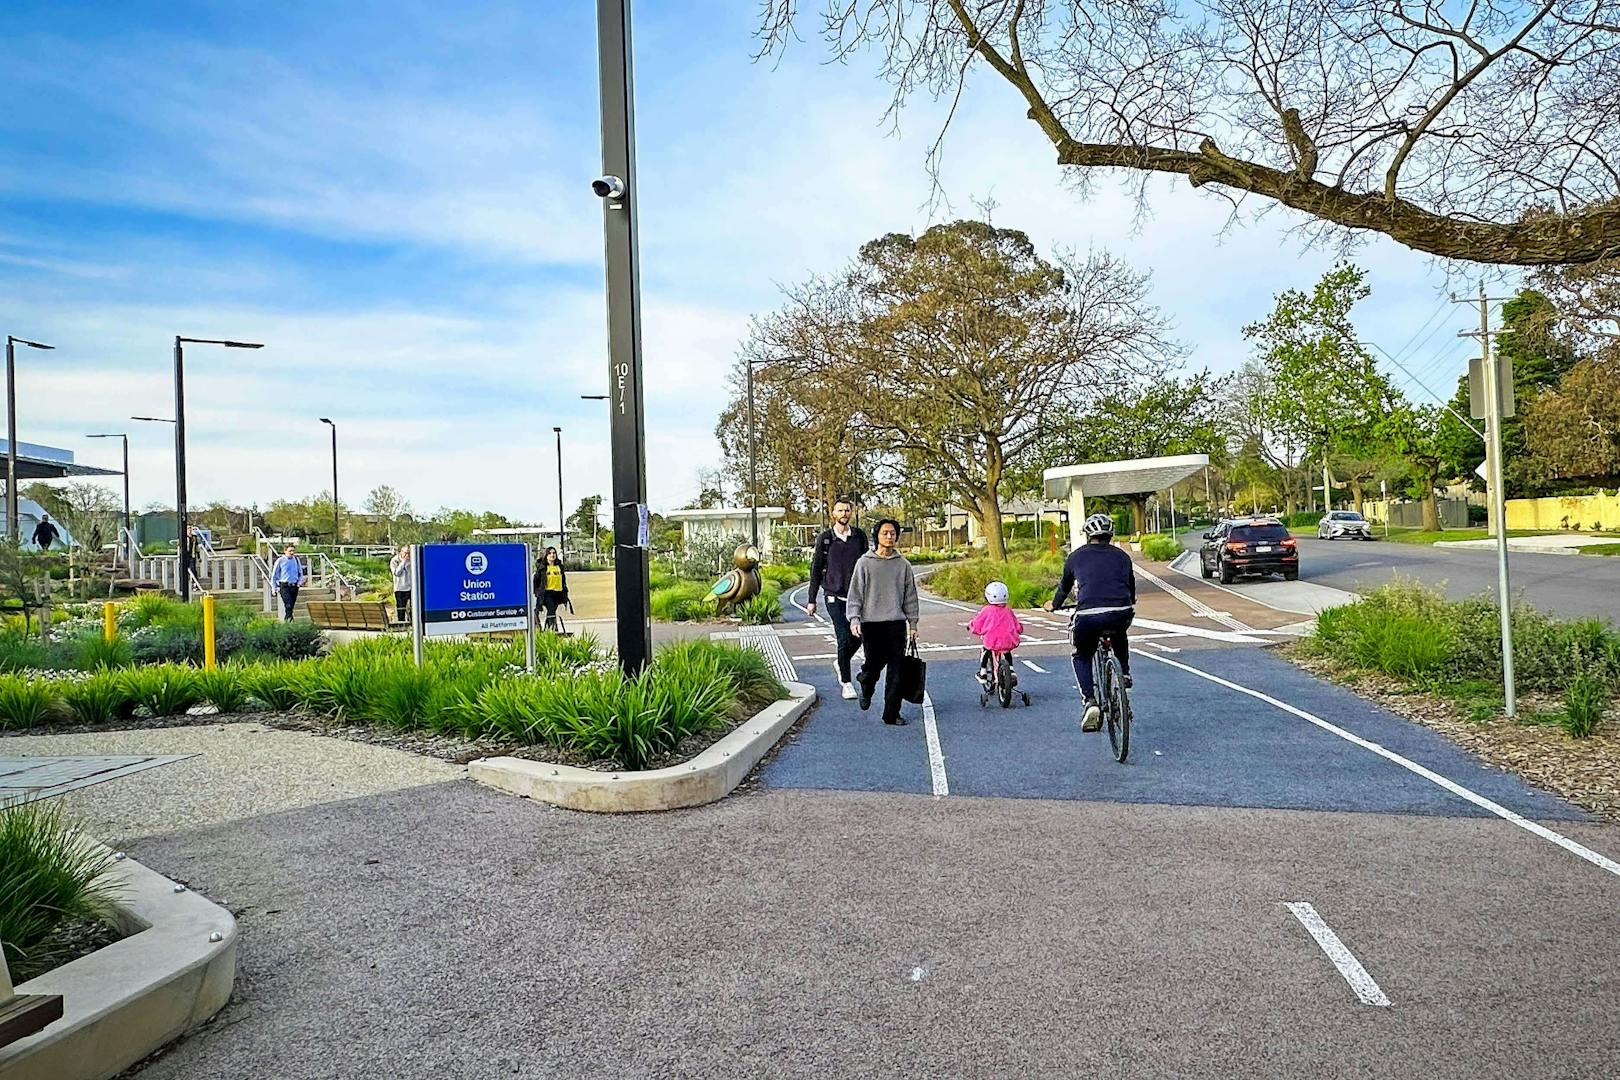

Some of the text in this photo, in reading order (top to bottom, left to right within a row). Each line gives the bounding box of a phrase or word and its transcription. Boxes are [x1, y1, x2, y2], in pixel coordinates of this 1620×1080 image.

[463, 579, 492, 589] Union
[460, 591, 495, 601] Station
[466, 610, 495, 618] Customer
